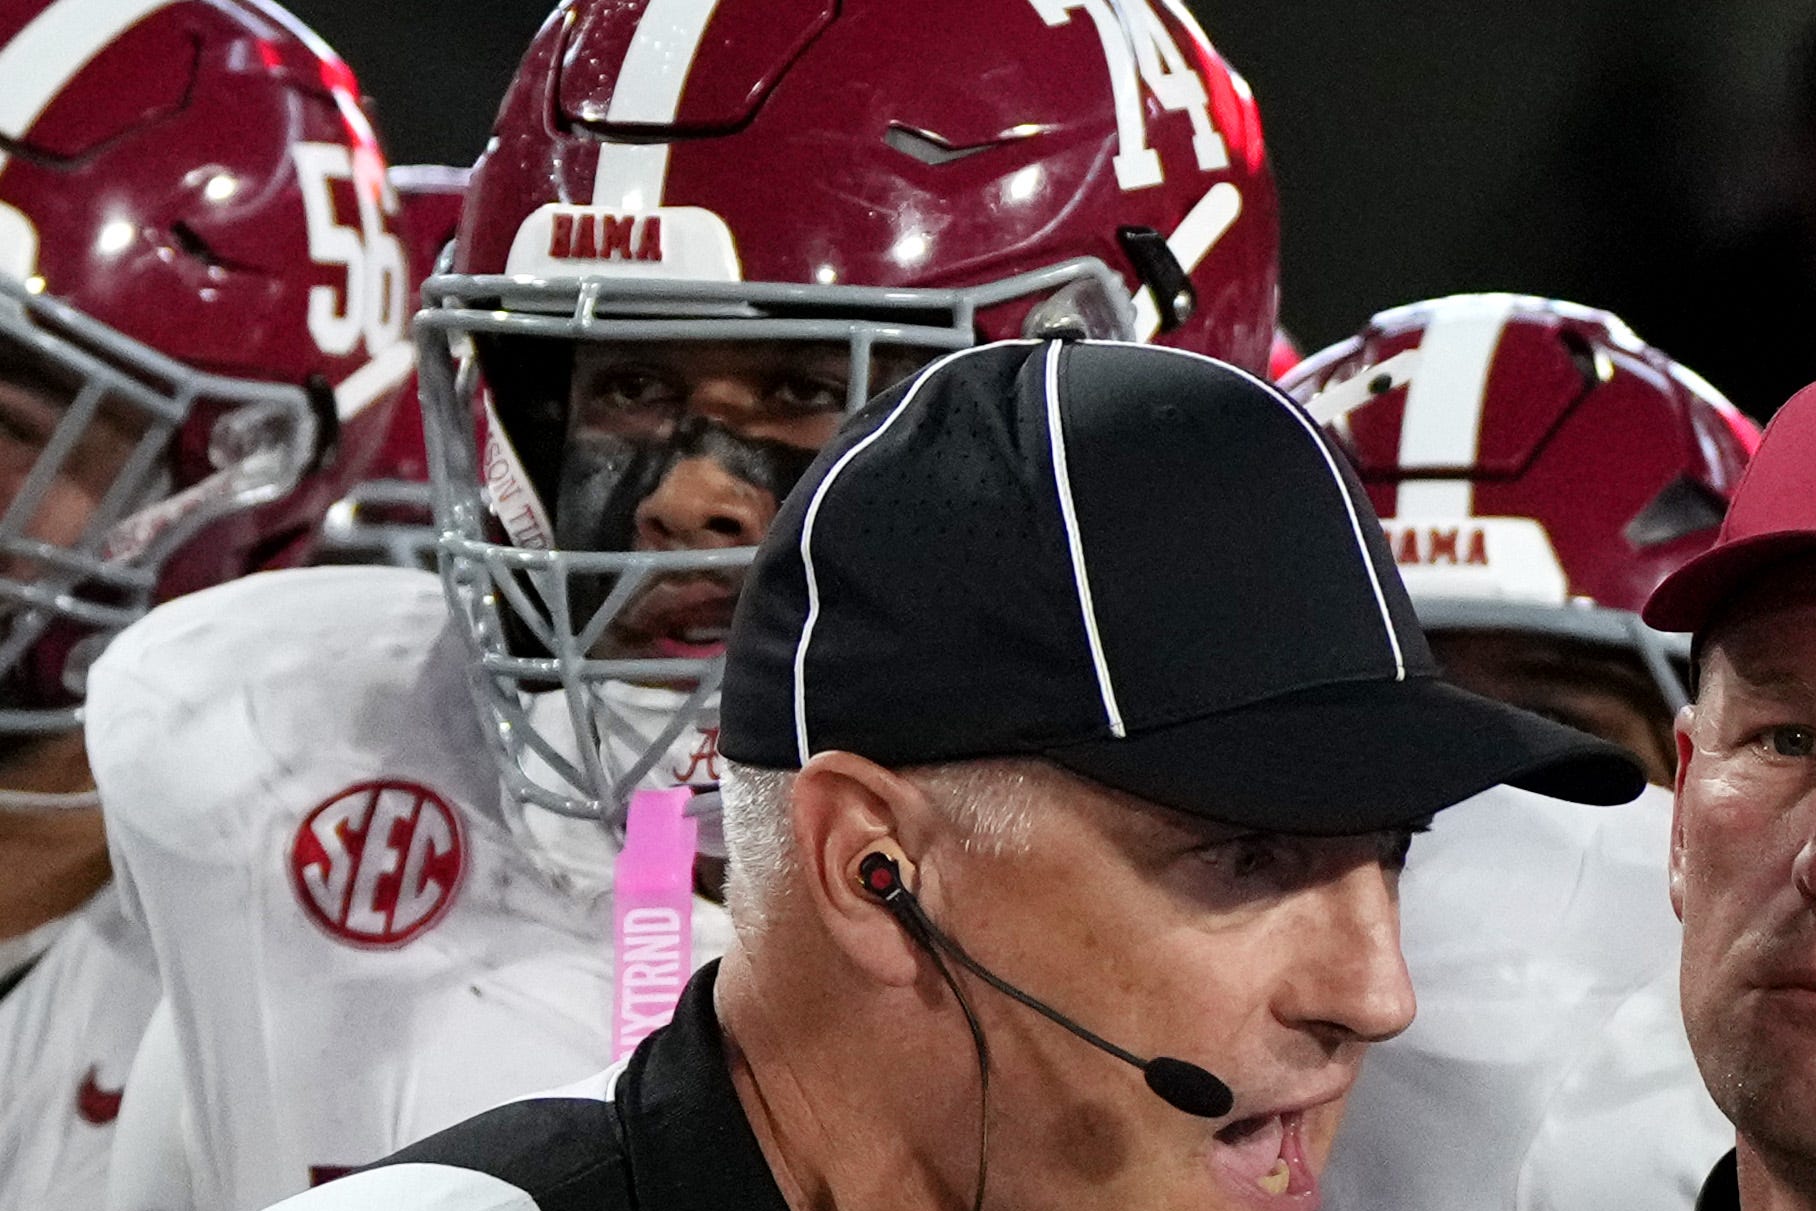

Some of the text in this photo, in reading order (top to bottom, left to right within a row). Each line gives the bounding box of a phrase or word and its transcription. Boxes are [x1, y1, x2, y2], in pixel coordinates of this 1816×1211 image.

[1028, 0, 1230, 191] 74
[292, 142, 408, 357] 56
[549, 213, 662, 262] BAMA
[1384, 528, 1489, 565] AMA
[302, 786, 452, 935] SEC
[620, 908, 681, 1067] XTRND
